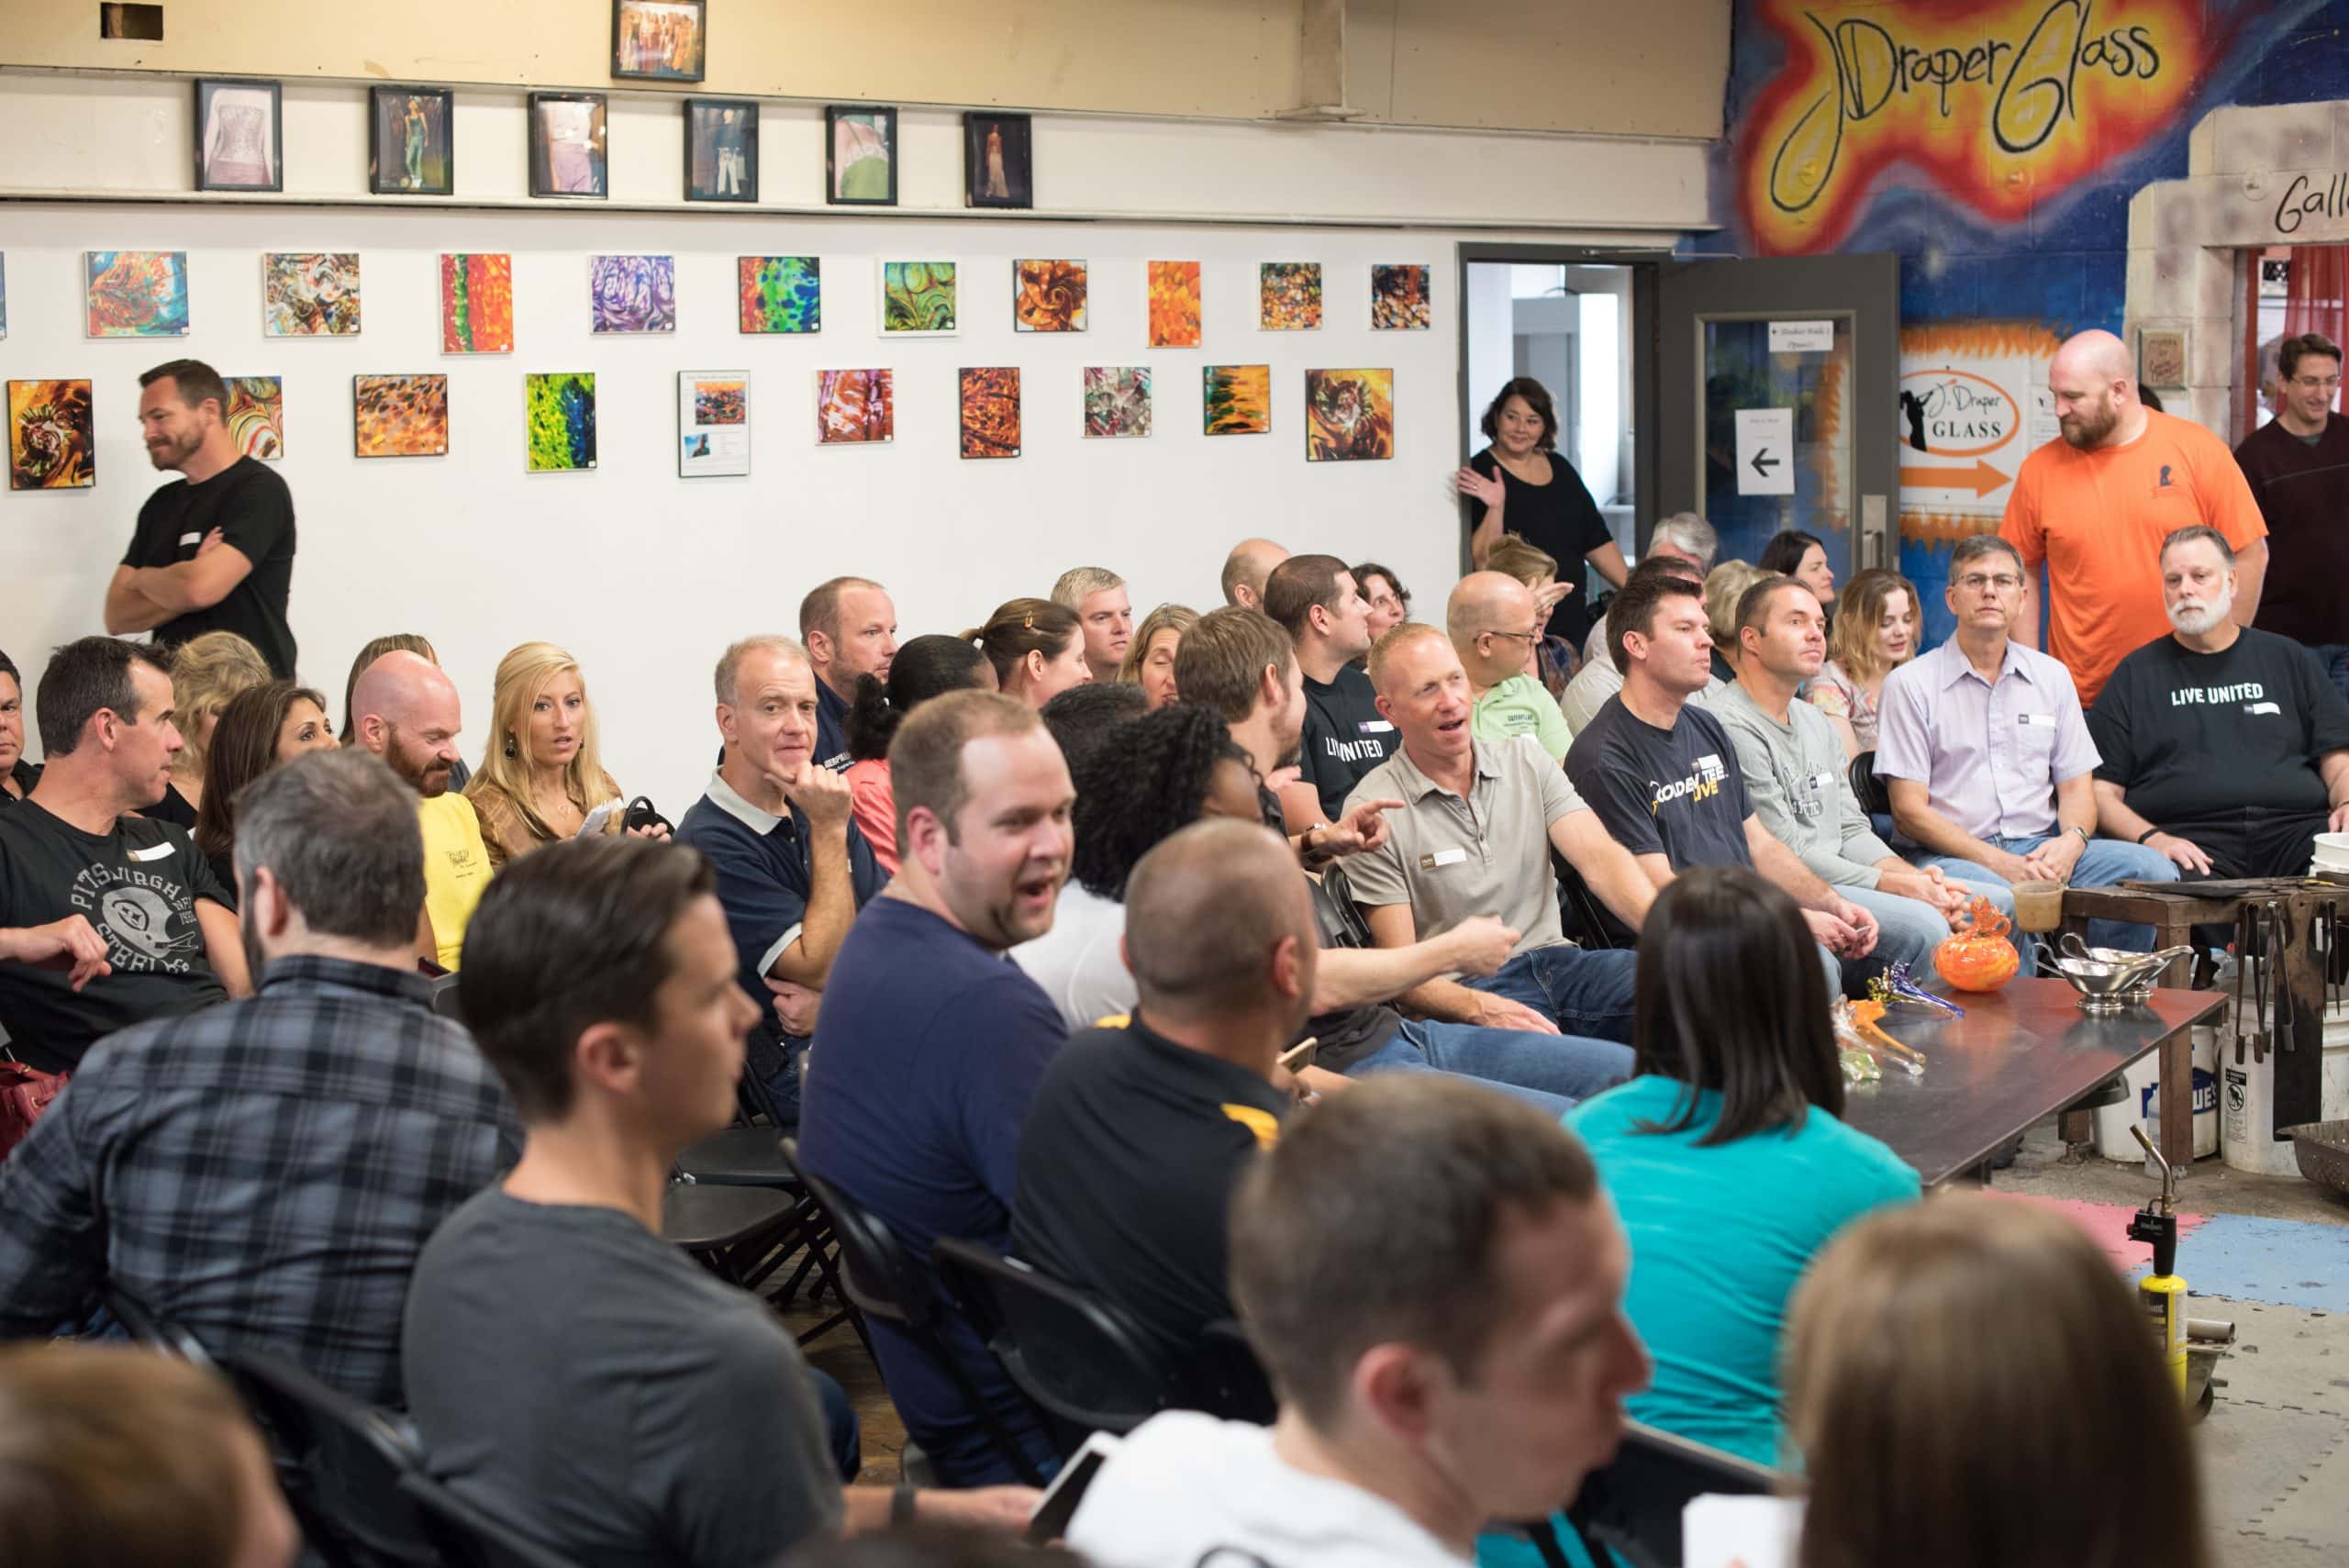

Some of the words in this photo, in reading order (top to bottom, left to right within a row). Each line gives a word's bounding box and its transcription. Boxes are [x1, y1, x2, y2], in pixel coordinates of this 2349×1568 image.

[1993, 0, 2160, 153] Glass
[2276, 172, 2349, 233] Gall
[1953, 384, 2002, 415] Draper
[1932, 420, 2001, 438] GLASS
[2170, 687, 2206, 706] LIVE
[2207, 683, 2264, 704] UNITED
[1702, 764, 1725, 782] TEE
